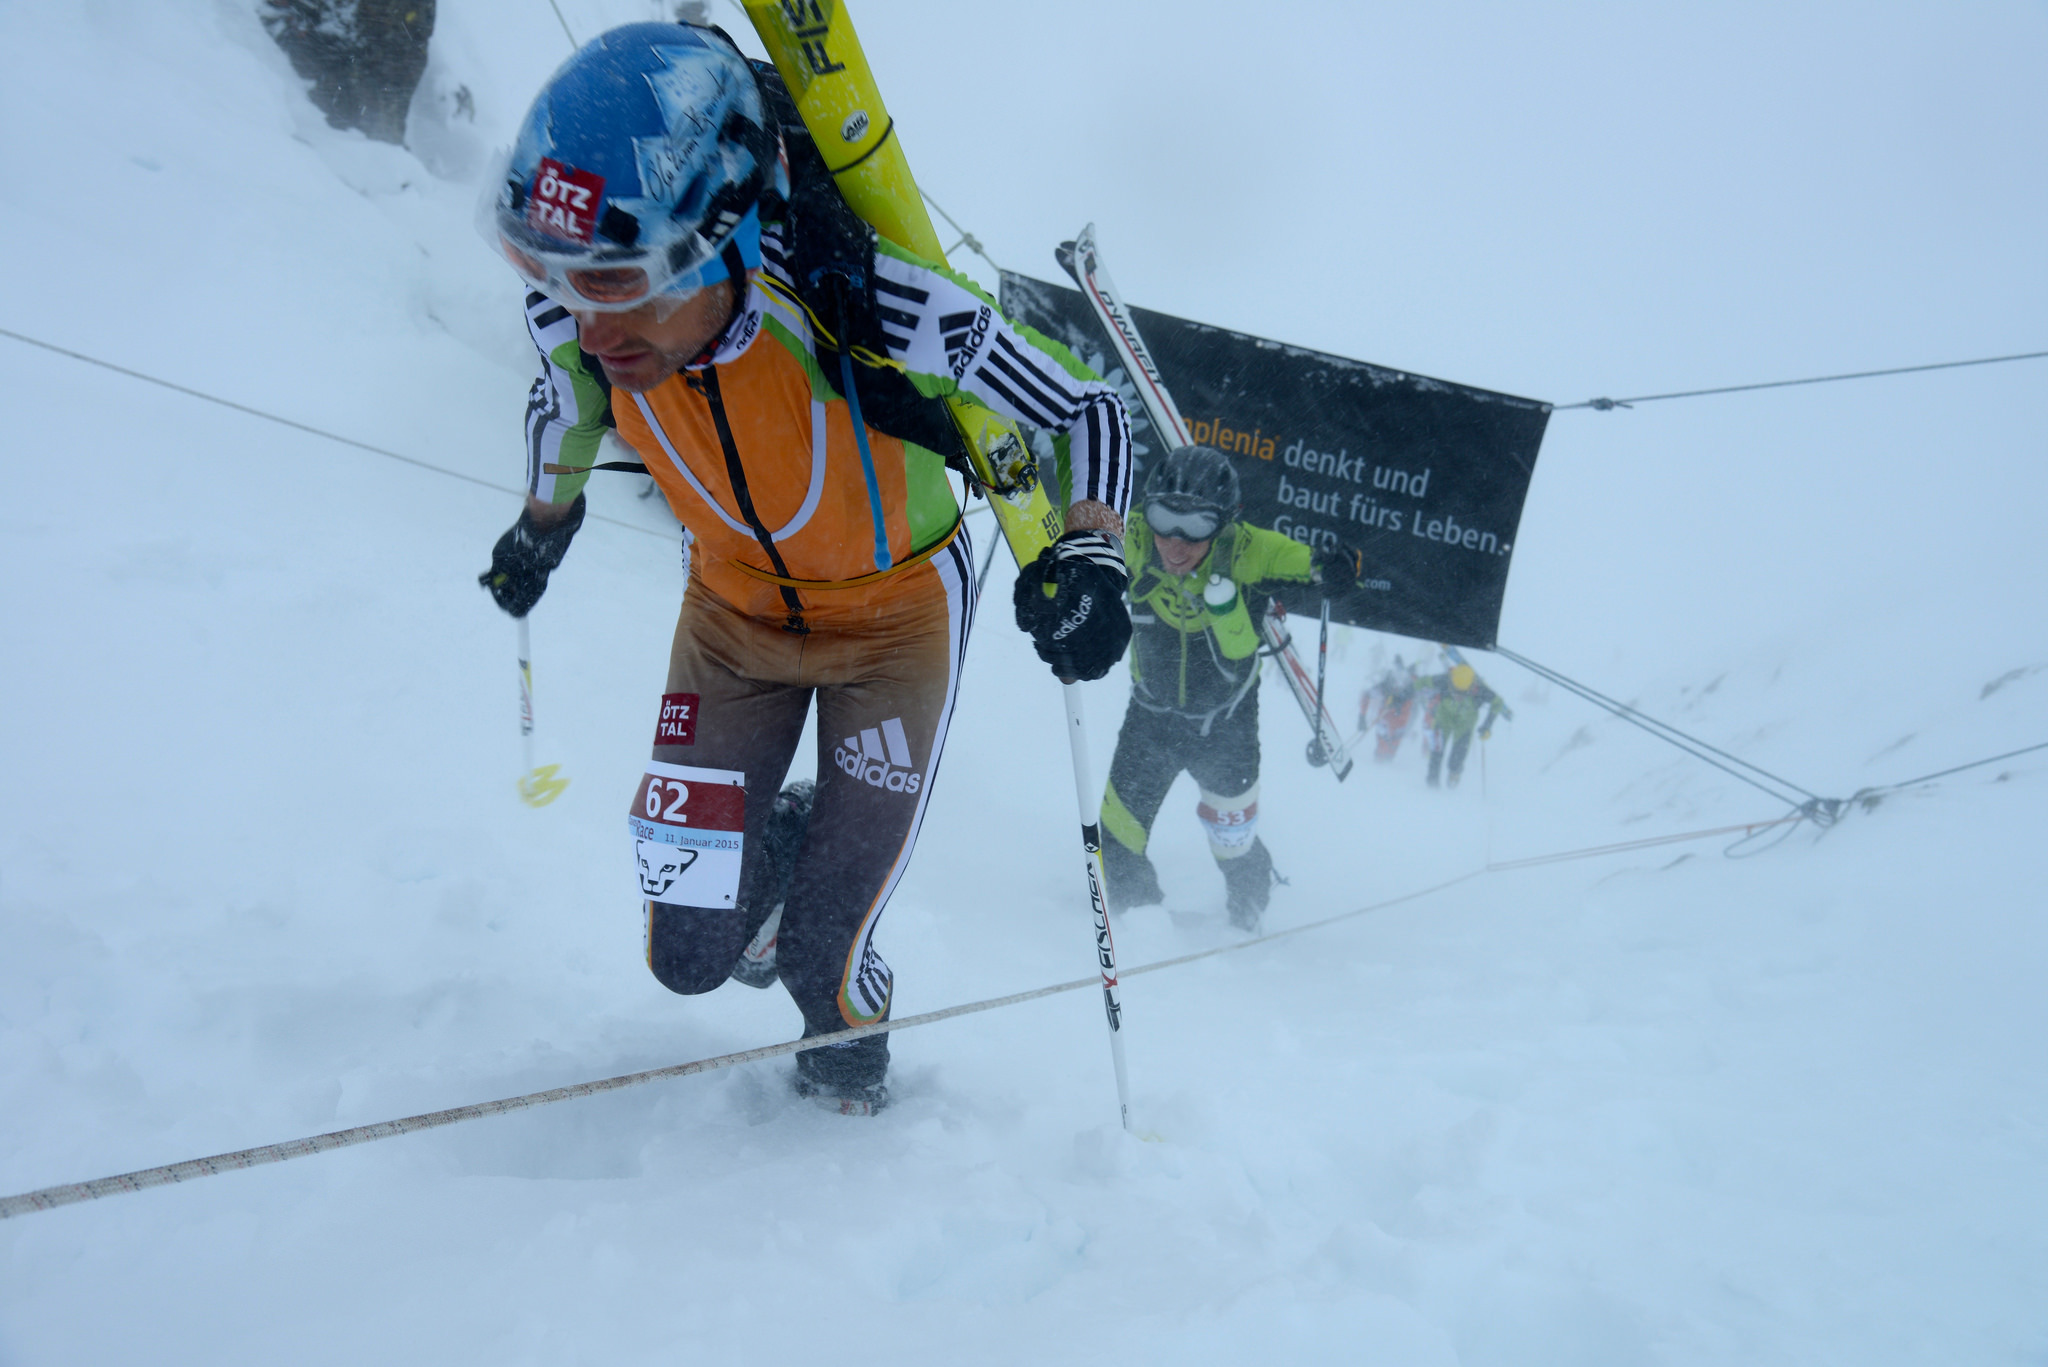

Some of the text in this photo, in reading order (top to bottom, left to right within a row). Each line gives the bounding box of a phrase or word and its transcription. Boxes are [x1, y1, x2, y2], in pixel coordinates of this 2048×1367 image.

[540, 166, 592, 211] ÖTZ
[536, 199, 584, 235] TAL
[953, 304, 992, 380] adidas
[1098, 291, 1163, 384] DYNAFIT
[1284, 438, 1366, 484] denkt
[1373, 465, 1431, 498] und
[1277, 475, 1504, 556] baut fürs Leben.
[1052, 594, 1093, 641] adidas
[660, 722, 687, 737] TAL
[662, 700, 690, 720] ÖTZ
[834, 746, 921, 794] adidas
[646, 777, 690, 824] 62
[665, 833, 677, 843] 11.
[680, 836, 713, 848] Januar
[714, 839, 739, 849] 2015
